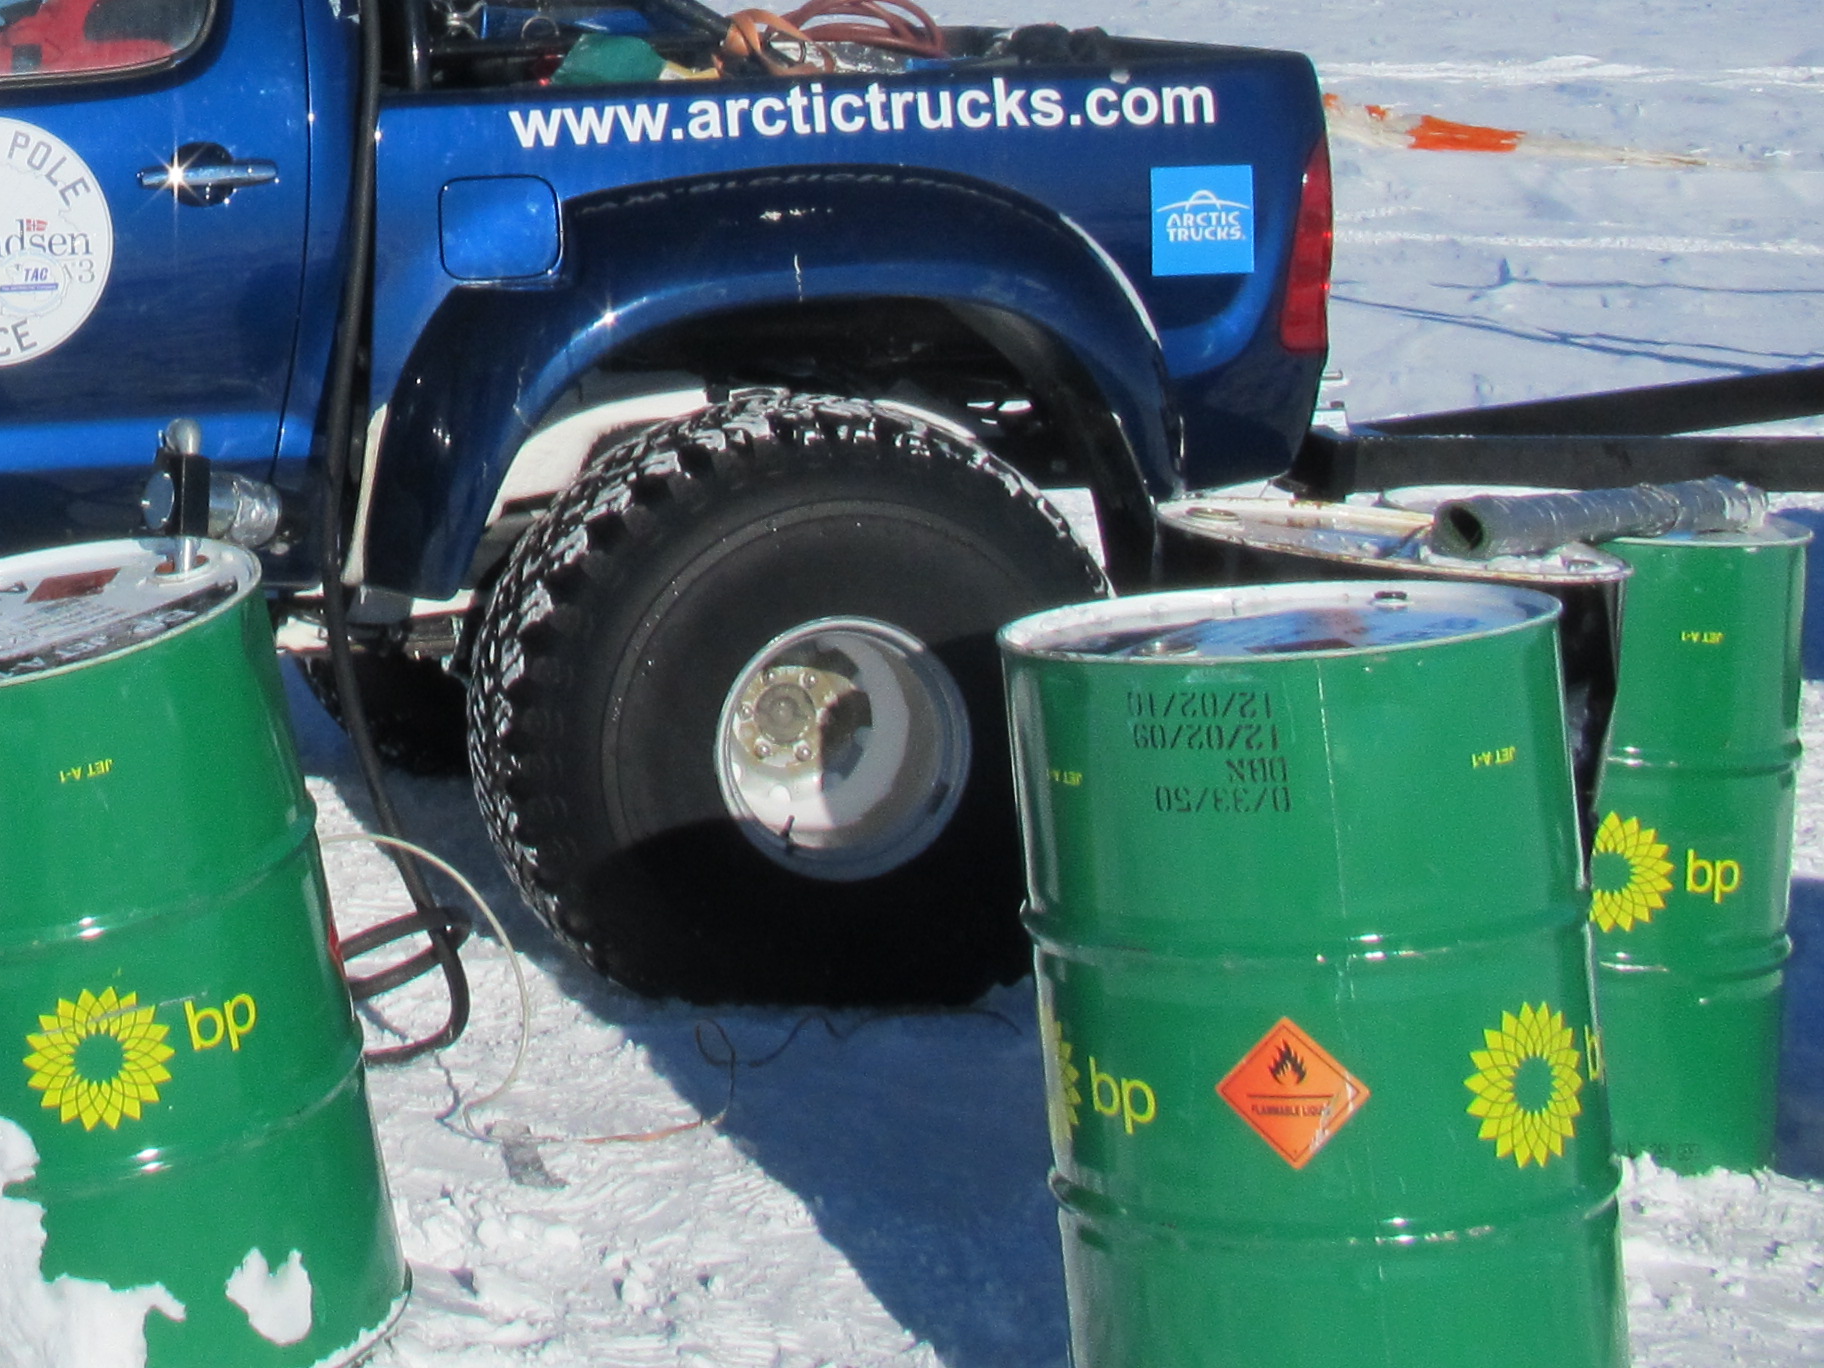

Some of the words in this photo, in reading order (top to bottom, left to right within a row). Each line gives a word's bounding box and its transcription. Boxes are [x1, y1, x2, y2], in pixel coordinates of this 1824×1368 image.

[508, 78, 1216, 148] www.arctictrucks.com
[7, 130, 91, 207] POLE
[1166, 210, 1241, 228] ARCTIC
[1166, 225, 1242, 243] TRUCKS
[24, 267, 49, 282] TAC
[1681, 631, 1700, 643] A-1
[1701, 631, 1725, 644] JET
[1132, 723, 1280, 751] 12/02/09
[1472, 751, 1493, 769] A-1
[1495, 745, 1516, 765] JET
[59, 766, 82, 783] A-1
[87, 758, 113, 778] JET
[1686, 847, 1741, 904] bp
[183, 993, 256, 1052] bp
[1584, 1024, 1603, 1082] b
[1089, 1055, 1157, 1135] bp
[1303, 1103, 1331, 1117] LIQU
